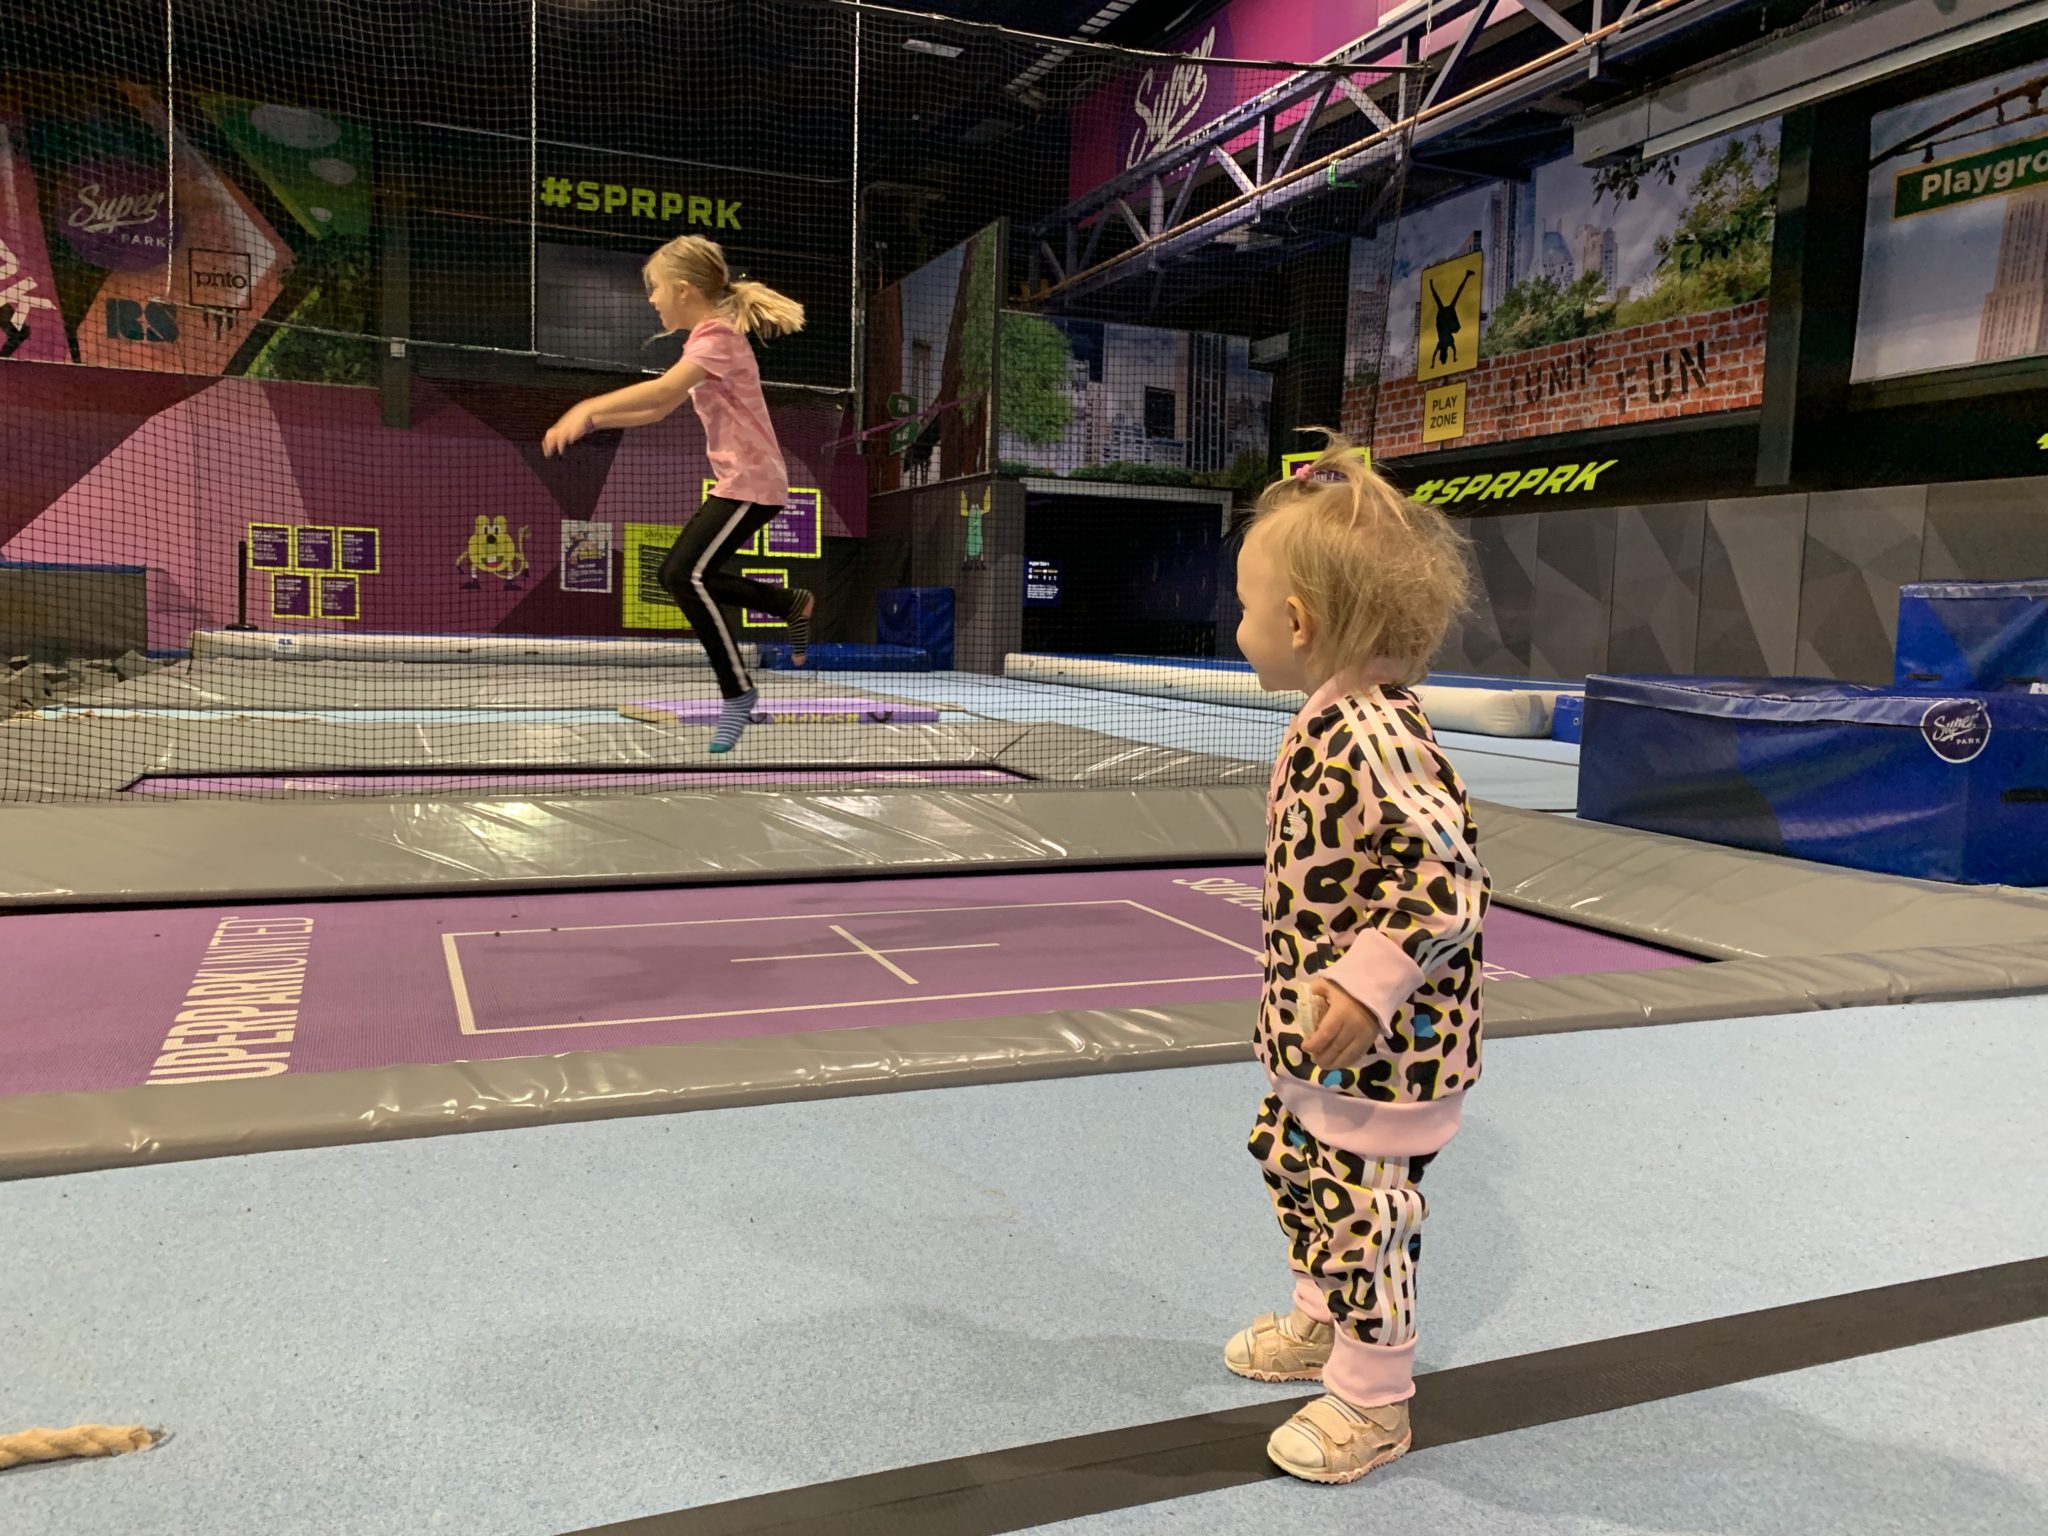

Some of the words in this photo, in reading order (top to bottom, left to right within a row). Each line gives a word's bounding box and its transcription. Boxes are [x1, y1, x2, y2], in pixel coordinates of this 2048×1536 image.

[1921, 150, 2048, 202] Playgro
[68, 182, 164, 234] Super
[540, 176, 743, 230] #SPRPRK
[121, 233, 169, 248] PARK
[1616, 341, 1706, 414] FUN
[1429, 412, 1458, 429] ZONE
[1432, 395, 1458, 412] PLAY
[1408, 459, 1618, 504] #SPRPRK
[1932, 712, 1980, 743] Super
[1956, 737, 1981, 745] PARK
